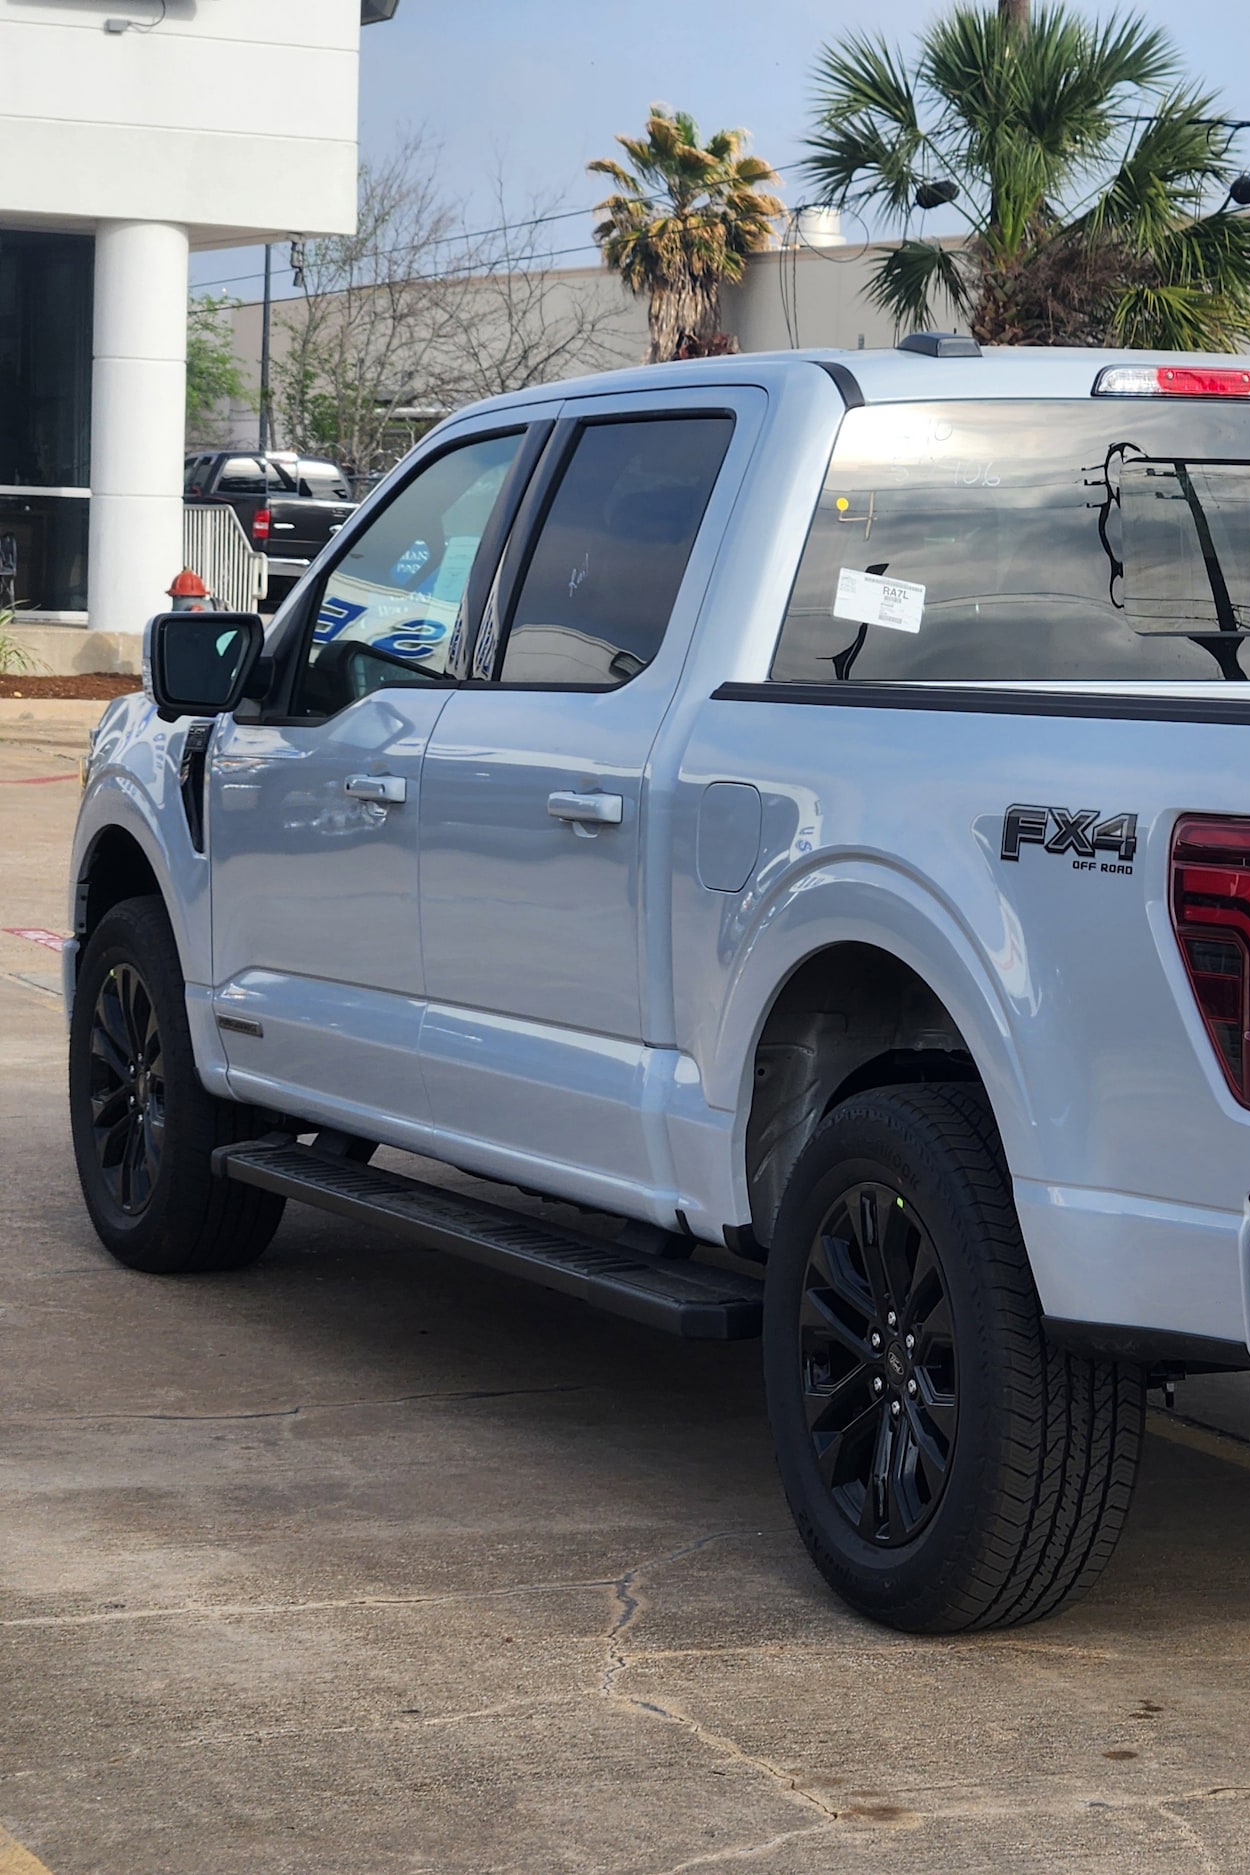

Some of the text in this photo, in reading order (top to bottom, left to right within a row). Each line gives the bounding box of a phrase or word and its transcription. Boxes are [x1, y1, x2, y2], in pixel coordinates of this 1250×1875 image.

[882, 586, 909, 600] RA7L
[1001, 803, 1138, 862] FX4
[1072, 860, 1133, 875] OFF ROAD
